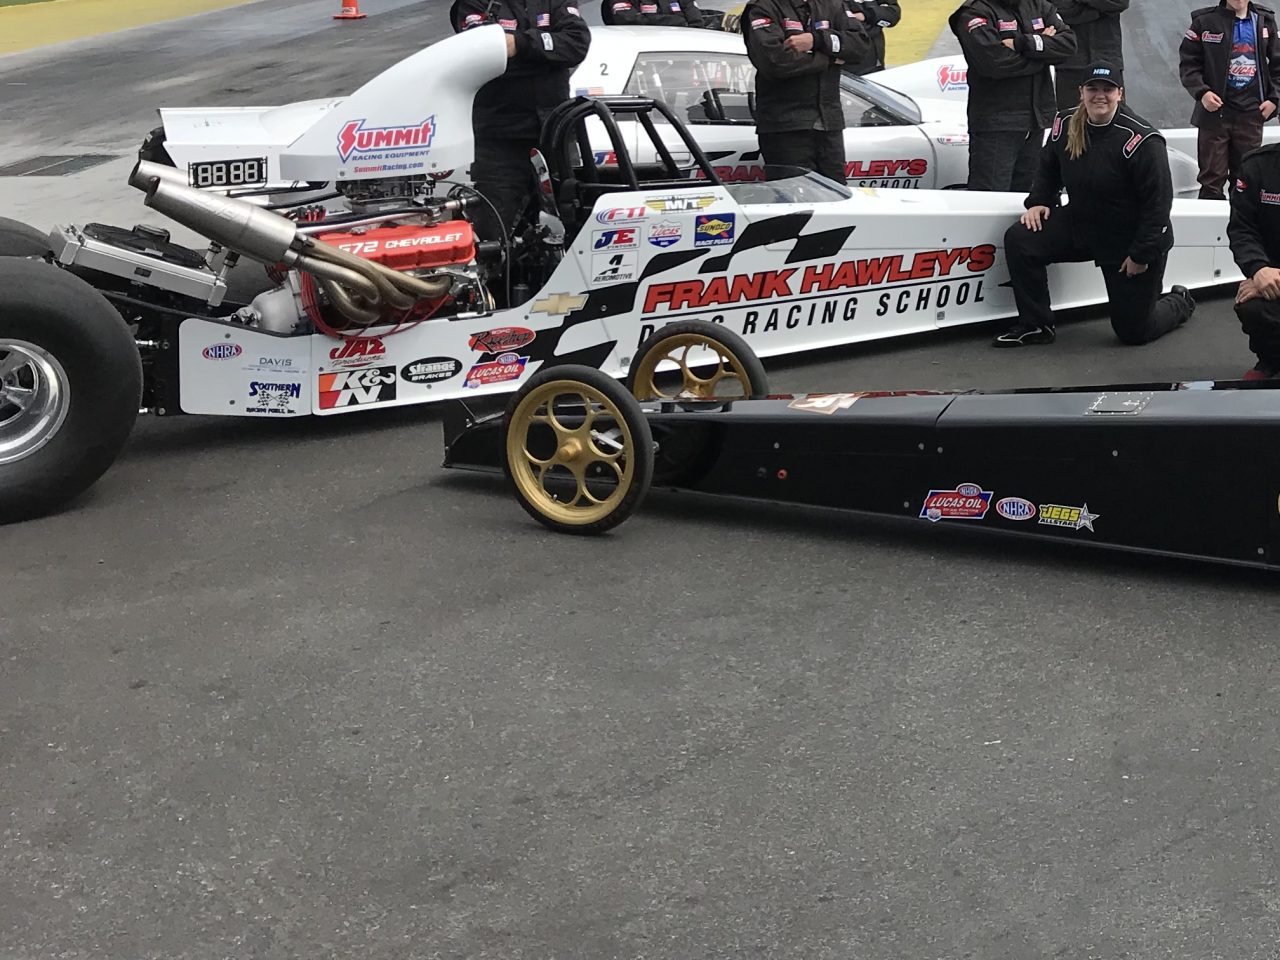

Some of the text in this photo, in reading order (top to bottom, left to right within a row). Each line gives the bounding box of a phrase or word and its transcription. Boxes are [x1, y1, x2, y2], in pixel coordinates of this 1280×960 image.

[599, 63, 609, 76] 2
[352, 150, 431, 161] RACING EQUIPMENT
[354, 162, 424, 173] SummitRacing.com
[607, 207, 646, 221] FTI
[652, 227, 680, 237] LUCAS
[699, 223, 731, 232] SUNOCO
[385, 233, 463, 249] CHEVROLET
[594, 228, 636, 250] JE
[594, 273, 633, 282] AEROMOTIVE
[642, 244, 996, 314] FRANK HAWLEY'S
[742, 296, 857, 335] RACING
[876, 279, 985, 317] SCHOOL
[208, 344, 238, 359] NHRA
[259, 357, 292, 366] DAVIS
[408, 360, 456, 376] Strange
[411, 371, 453, 381] BRAKES
[471, 366, 504, 379] LUCAS
[504, 364, 520, 373] OIL
[249, 381, 301, 398] SOUTHERN
[961, 487, 977, 496] NHRA
[930, 497, 983, 509] LUCAS OIL
[1002, 501, 1030, 517] NHRA
[1041, 506, 1081, 521] JEGS
[1039, 518, 1078, 528] ALLSTARS
